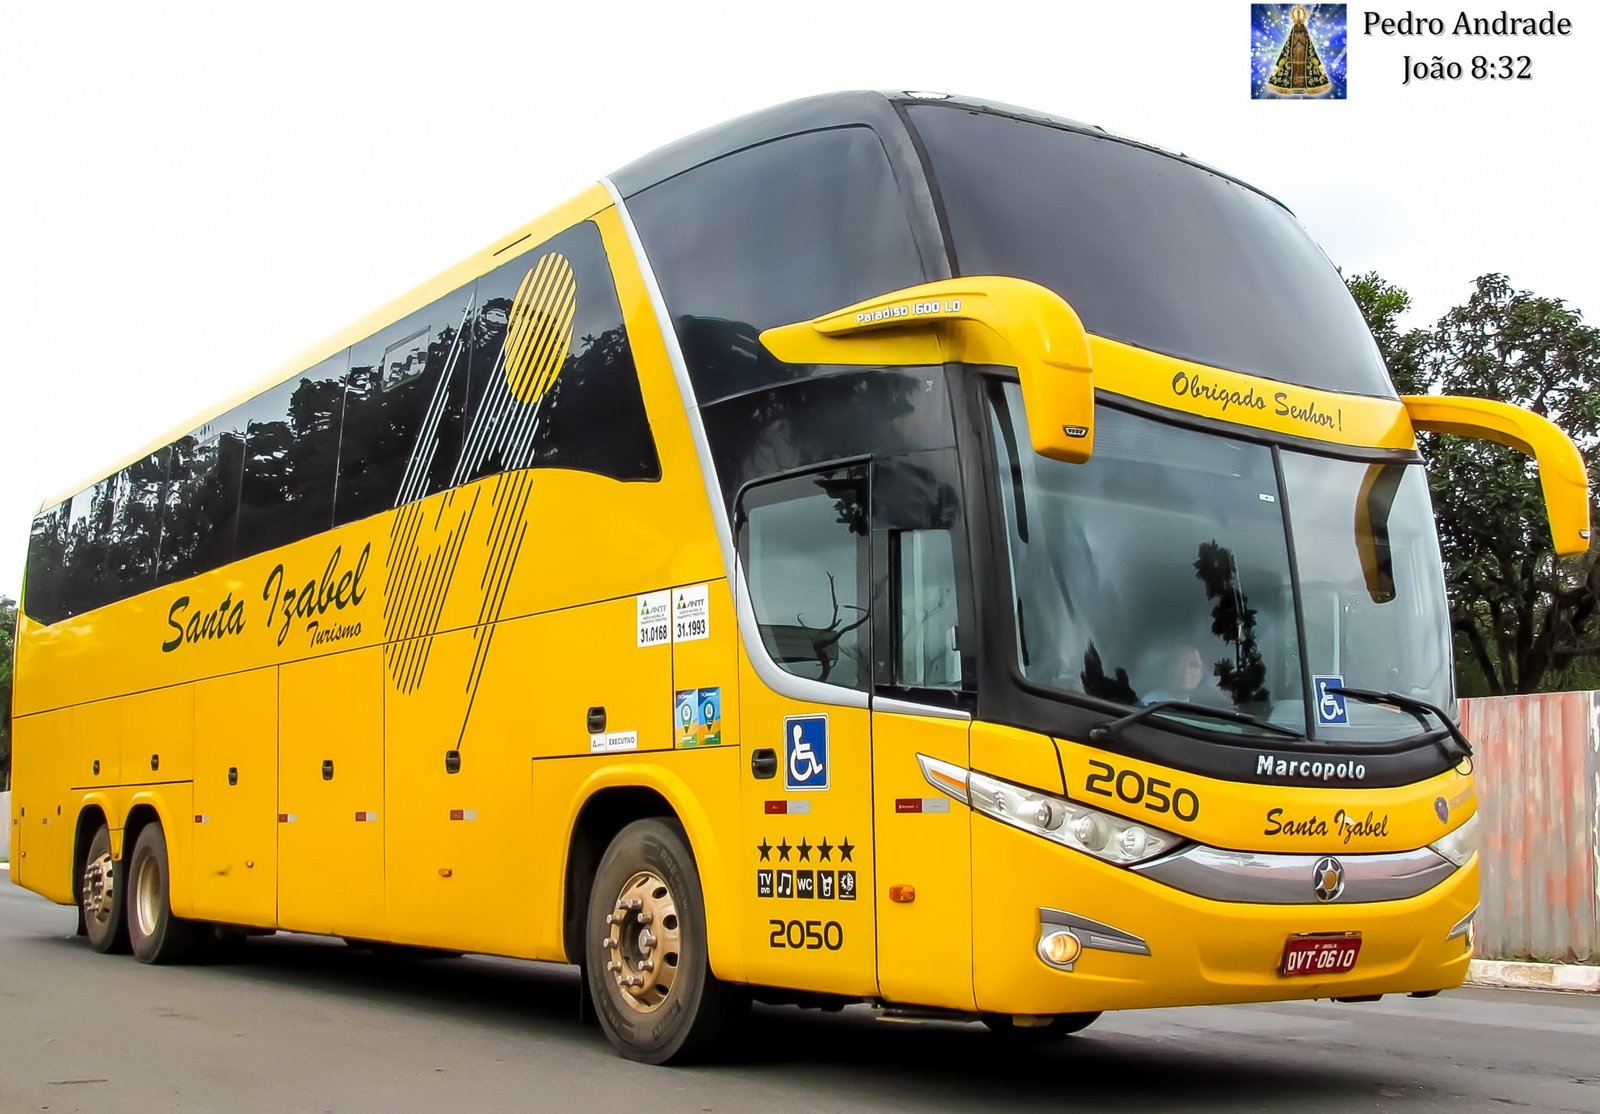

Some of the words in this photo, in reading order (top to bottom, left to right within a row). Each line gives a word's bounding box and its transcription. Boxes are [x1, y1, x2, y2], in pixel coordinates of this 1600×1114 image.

[856, 306, 909, 324] Paradiso
[912, 301, 940, 315] 1600
[1172, 371, 1266, 411] Obrigado
[1274, 392, 1342, 431] Senhor!
[162, 592, 246, 653] Santa
[263, 541, 371, 647] Izabel
[687, 599, 704, 608] ANTT
[650, 605, 666, 613] ANTT
[306, 620, 362, 648] Turismo
[641, 625, 667, 643] 31.0168
[677, 619, 706, 638] 31.1993
[608, 736, 635, 746] EXECUTIVO
[1256, 755, 1366, 781] Marcopolo
[1085, 759, 1199, 822] 2050
[1264, 807, 1328, 836] Santa
[1334, 808, 1389, 845] Izabel
[759, 873, 772, 886] TV
[797, 878, 813, 891] WC
[769, 919, 843, 950] 2050
